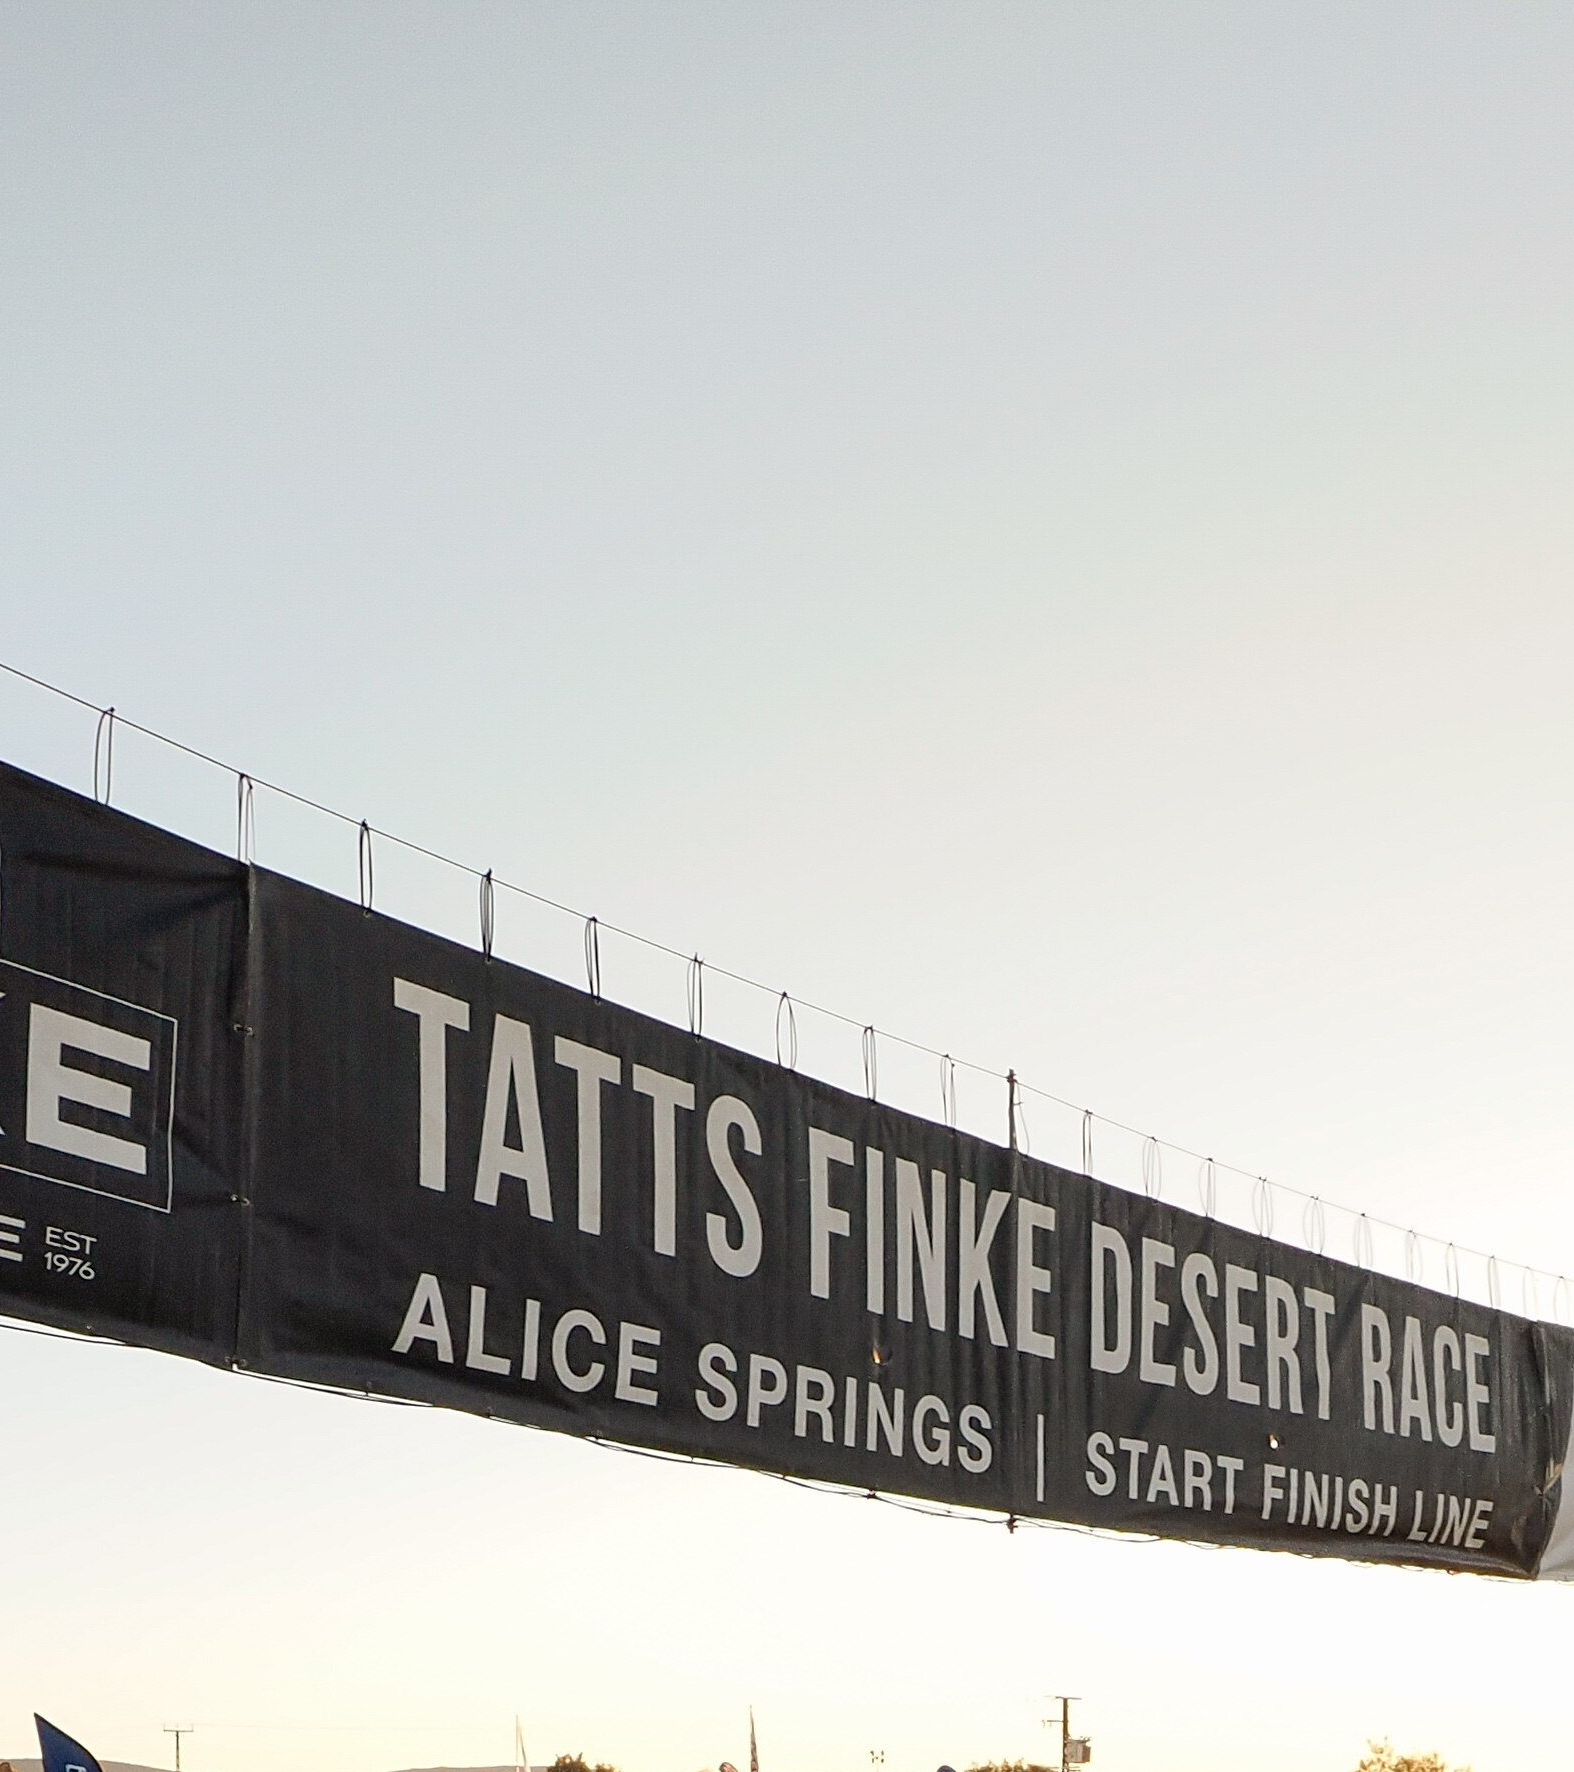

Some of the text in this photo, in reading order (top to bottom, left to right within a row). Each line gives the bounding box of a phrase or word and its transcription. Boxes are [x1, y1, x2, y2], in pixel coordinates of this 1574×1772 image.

[43, 1225, 98, 1256] EST
[43, 1250, 97, 1281] 1976
[393, 977, 1497, 1455] TATTS FINKE DESERT RACE
[392, 1272, 1496, 1550] ALICE SPRINGS START FINISH LINE
